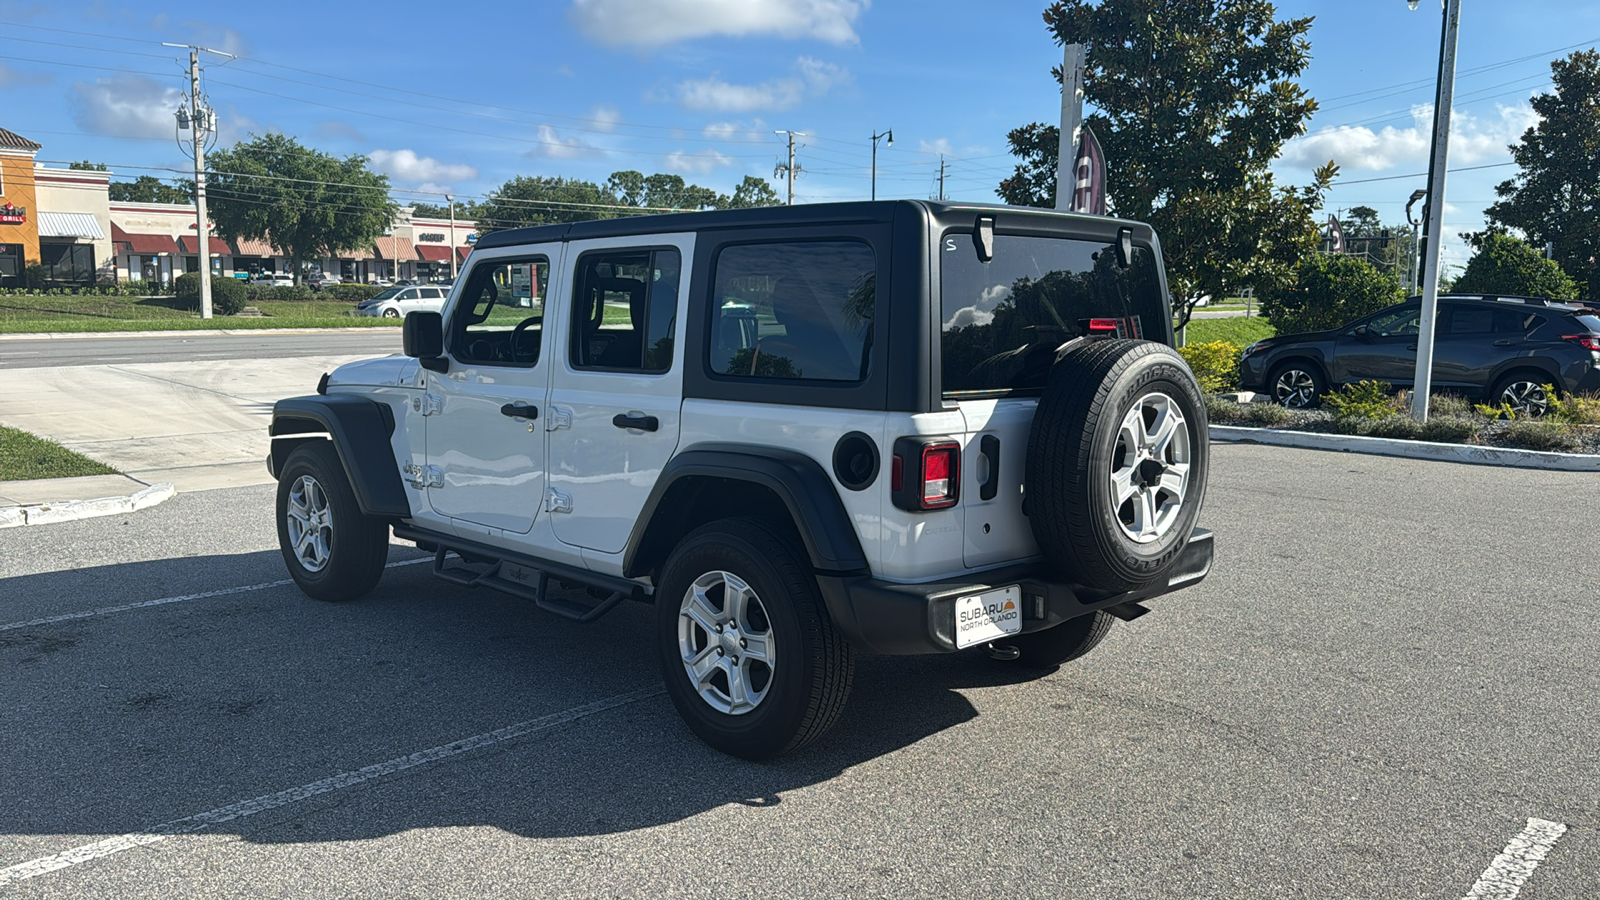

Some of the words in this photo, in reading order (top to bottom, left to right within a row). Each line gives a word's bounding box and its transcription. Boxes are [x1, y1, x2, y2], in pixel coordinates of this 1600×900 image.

[945, 238, 957, 252] S
[1116, 535, 1184, 571] DUELER
[959, 601, 1004, 623] SUBARU
[960, 620, 983, 633] NORTH
[983, 611, 1018, 626] ORLANDO
